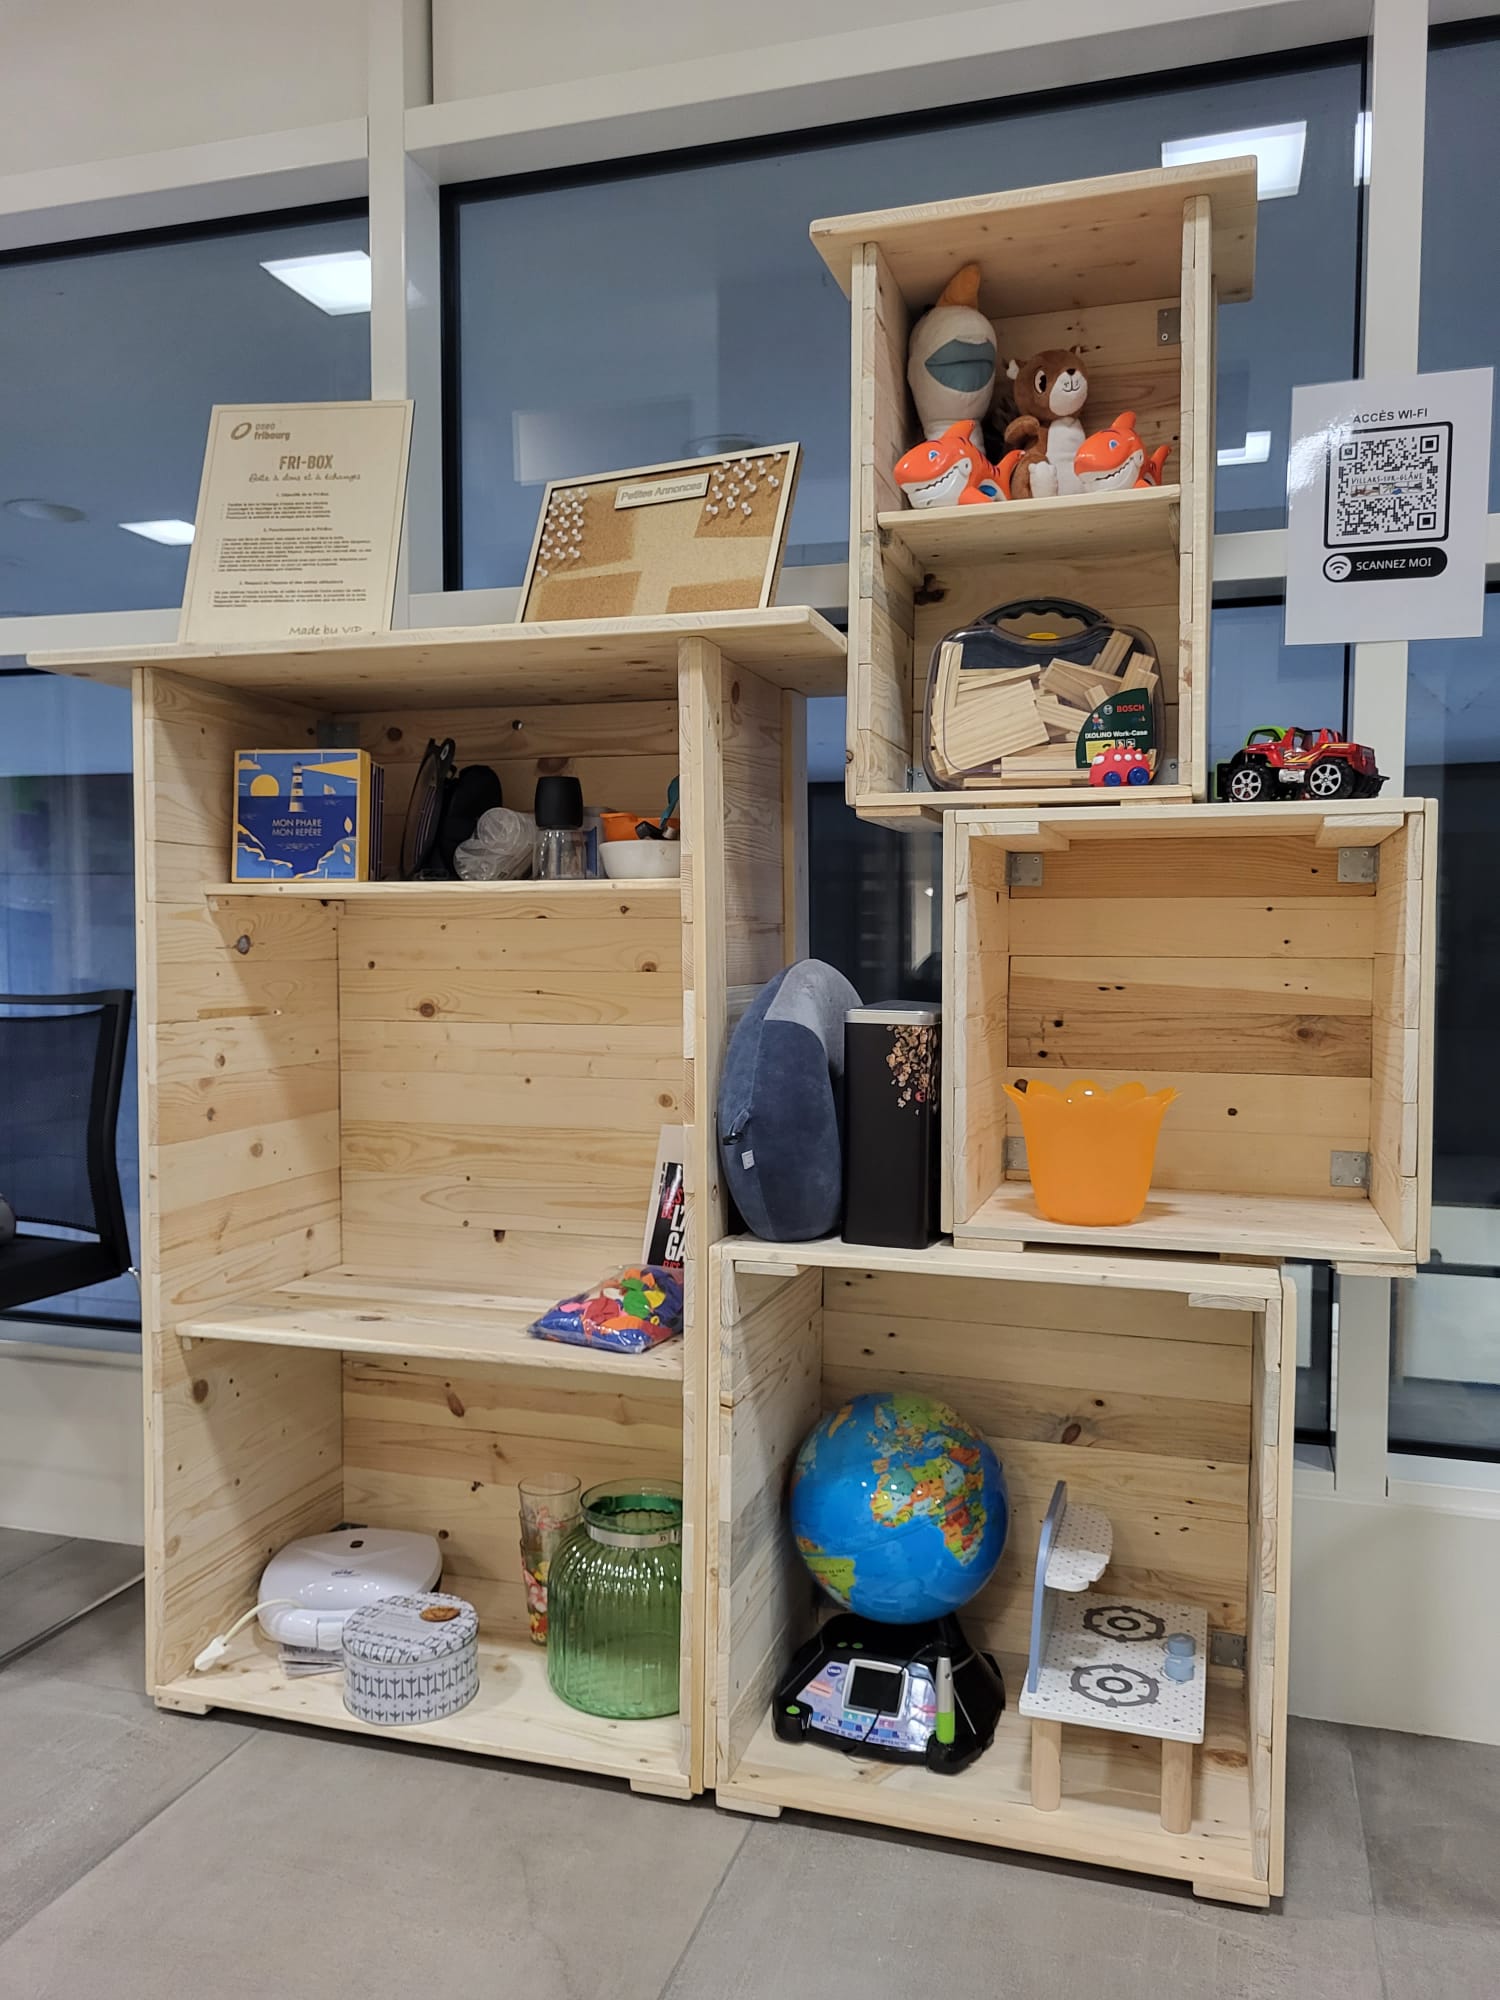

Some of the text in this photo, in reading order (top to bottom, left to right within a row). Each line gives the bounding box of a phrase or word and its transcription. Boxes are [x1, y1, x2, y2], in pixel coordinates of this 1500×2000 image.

[1353, 408, 1428, 424] ACCÈS WI-FI
[254, 431, 291, 441] fribourg
[279, 454, 333, 470] FRI-BOX
[621, 482, 703, 501] Petites Annonces
[1356, 557, 1432, 571] SCANNEZ MOI
[289, 625, 320, 636] Made
[1116, 704, 1145, 713] BOSCH
[1113, 730, 1148, 738] Work-Case
[272, 818, 322, 827] MON PHARE
[272, 828, 294, 836] MON
